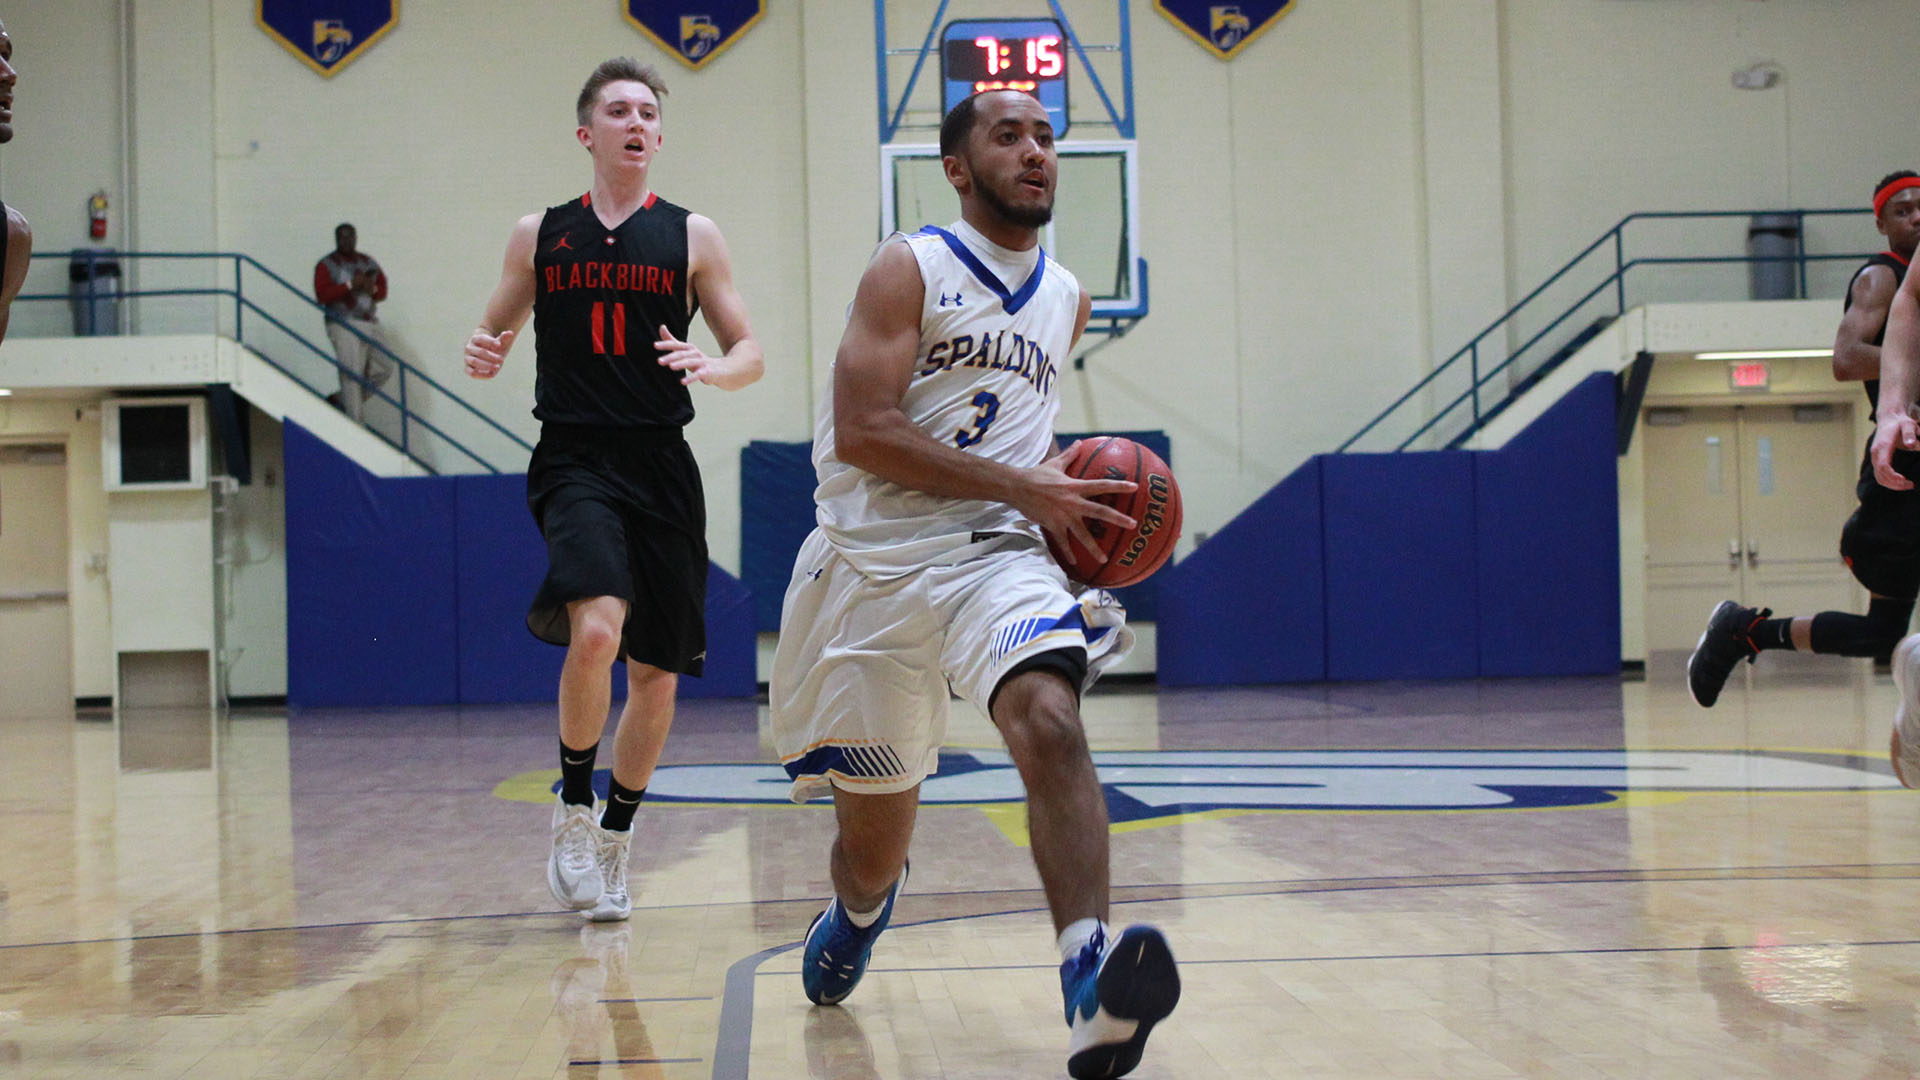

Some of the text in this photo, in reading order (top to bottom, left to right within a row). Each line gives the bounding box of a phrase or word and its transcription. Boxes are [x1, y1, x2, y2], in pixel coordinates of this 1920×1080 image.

[545, 262, 675, 296] BLACKBURN
[591, 301, 626, 355] 11
[955, 390, 1001, 449] 3
[1117, 473, 1169, 568] Wilson
